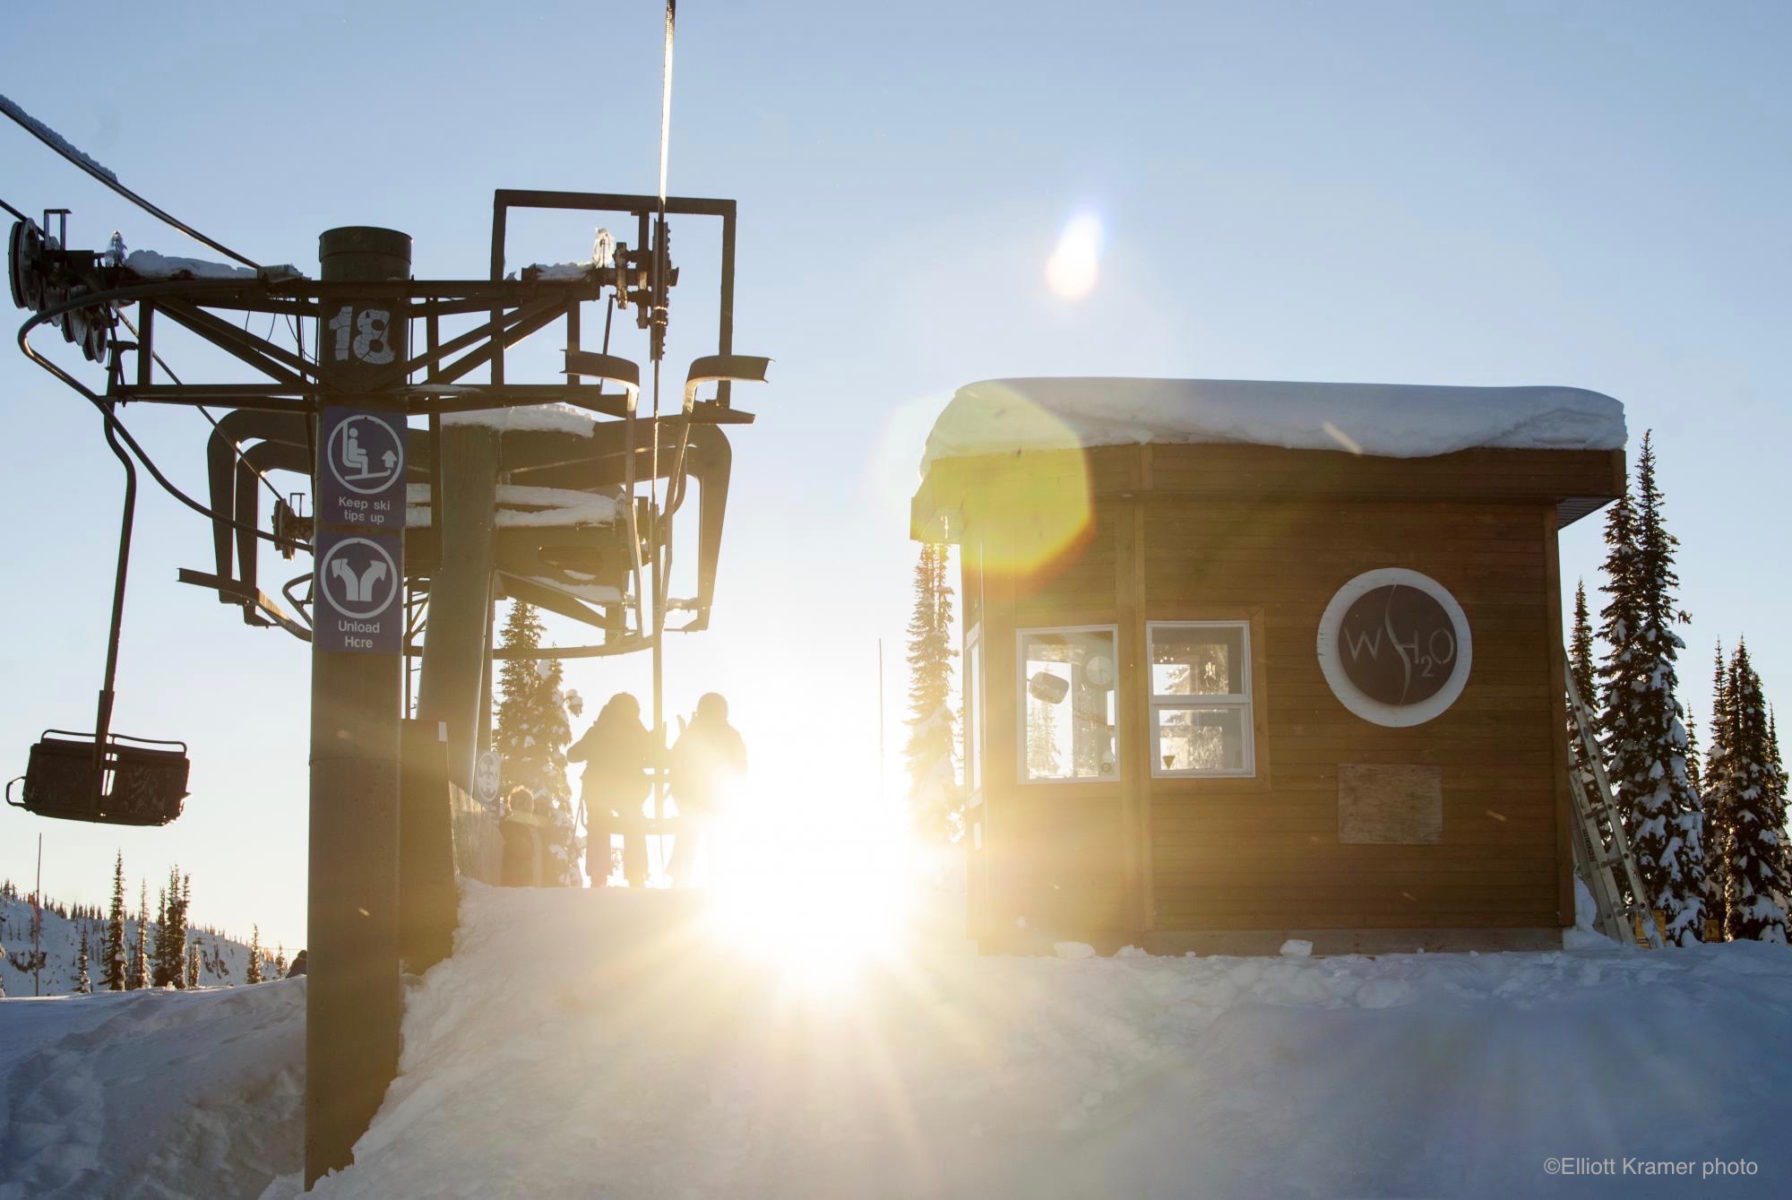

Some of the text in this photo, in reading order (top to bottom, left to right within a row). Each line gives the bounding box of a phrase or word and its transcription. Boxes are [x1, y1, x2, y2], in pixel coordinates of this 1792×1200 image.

[328, 306, 396, 365] 18
[338, 496, 391, 511] Keep ski
[344, 509, 385, 526] tips up
[338, 620, 380, 633] Unload
[345, 636, 374, 648] Here
